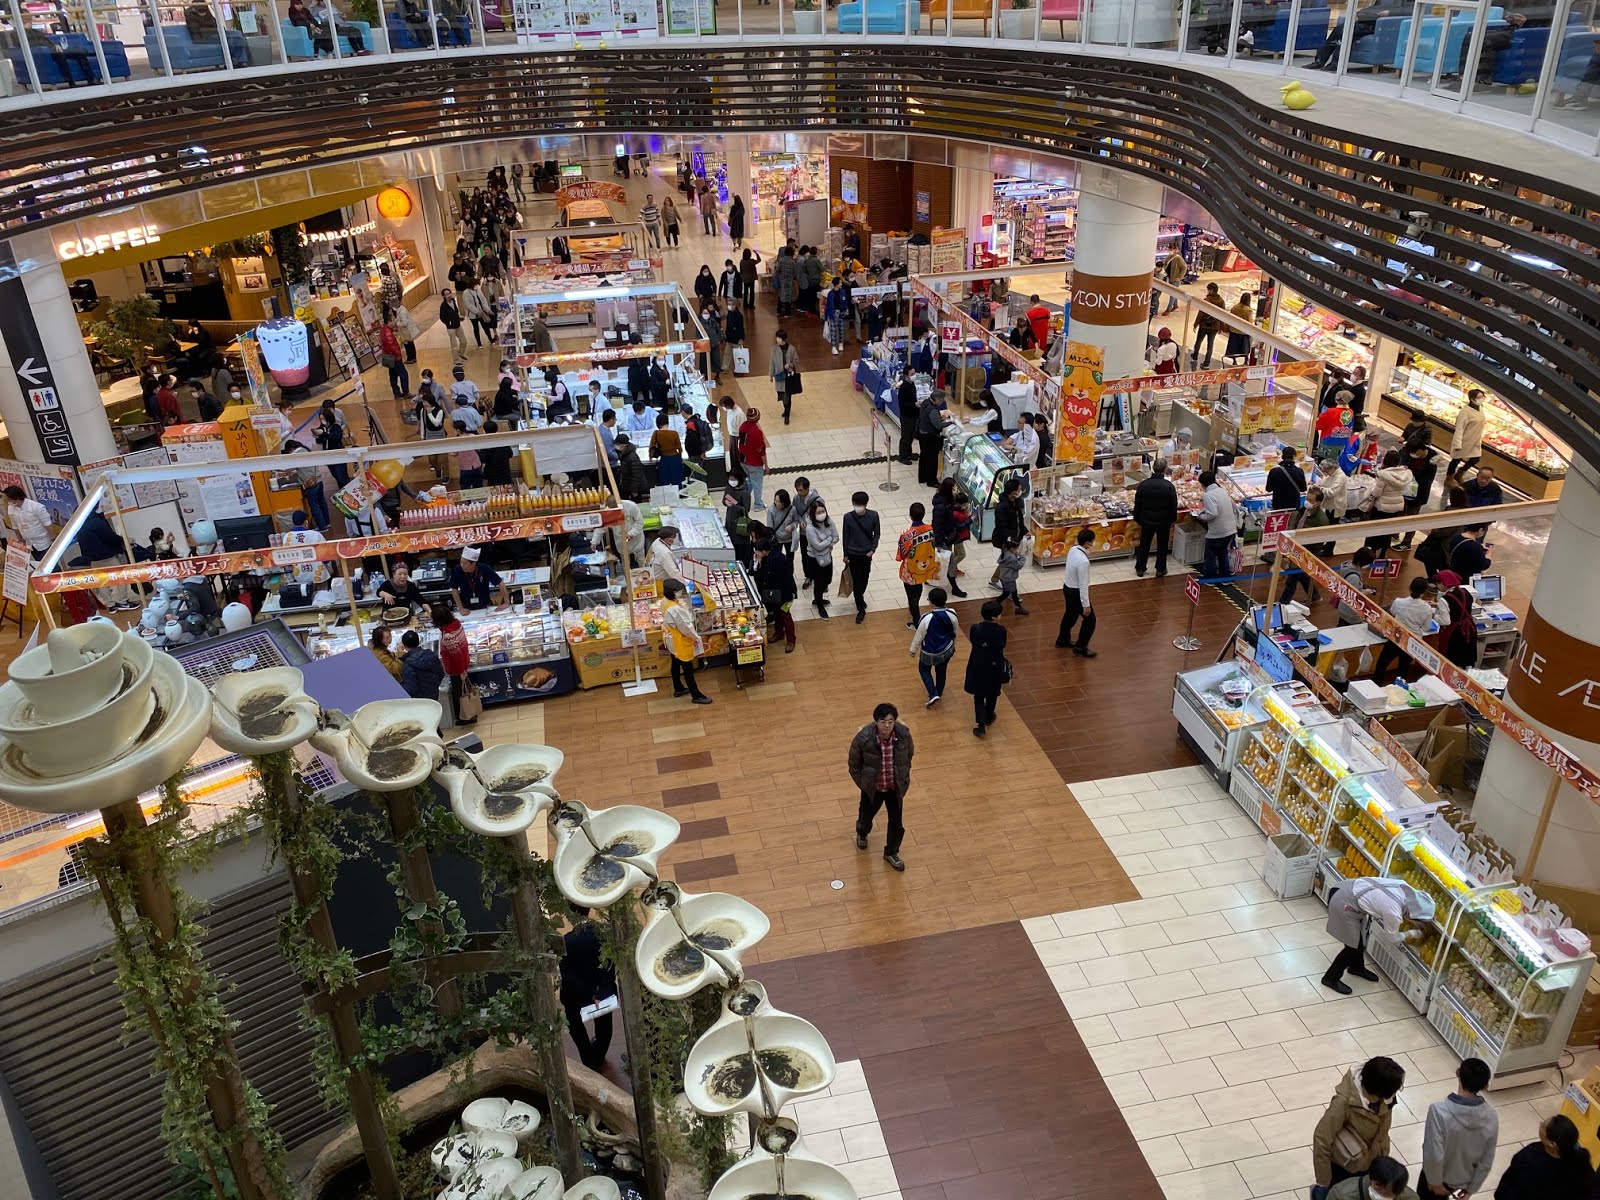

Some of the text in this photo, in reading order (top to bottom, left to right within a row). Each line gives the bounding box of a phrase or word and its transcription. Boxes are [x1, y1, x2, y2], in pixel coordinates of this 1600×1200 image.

[59, 225, 160, 259] COFFEE
[310, 221, 376, 242] PABLO COFFEE
[566, 263, 608, 275] 愛媛県フェア
[1115, 288, 1152, 309] STYLE
[1069, 354, 1100, 367] MICAN
[1163, 371, 1219, 388] 愛媛県フェア
[1067, 401, 1093, 416] えひめ
[409, 523, 524, 546] 第4回 愛媛県フェア
[108, 557, 231, 581] 第4回 愛媛県フェア
[1187, 584, 1199, 600] 入口
[1327, 574, 1380, 622] 愛媛県フェア
[1489, 704, 1517, 733] 第4回
